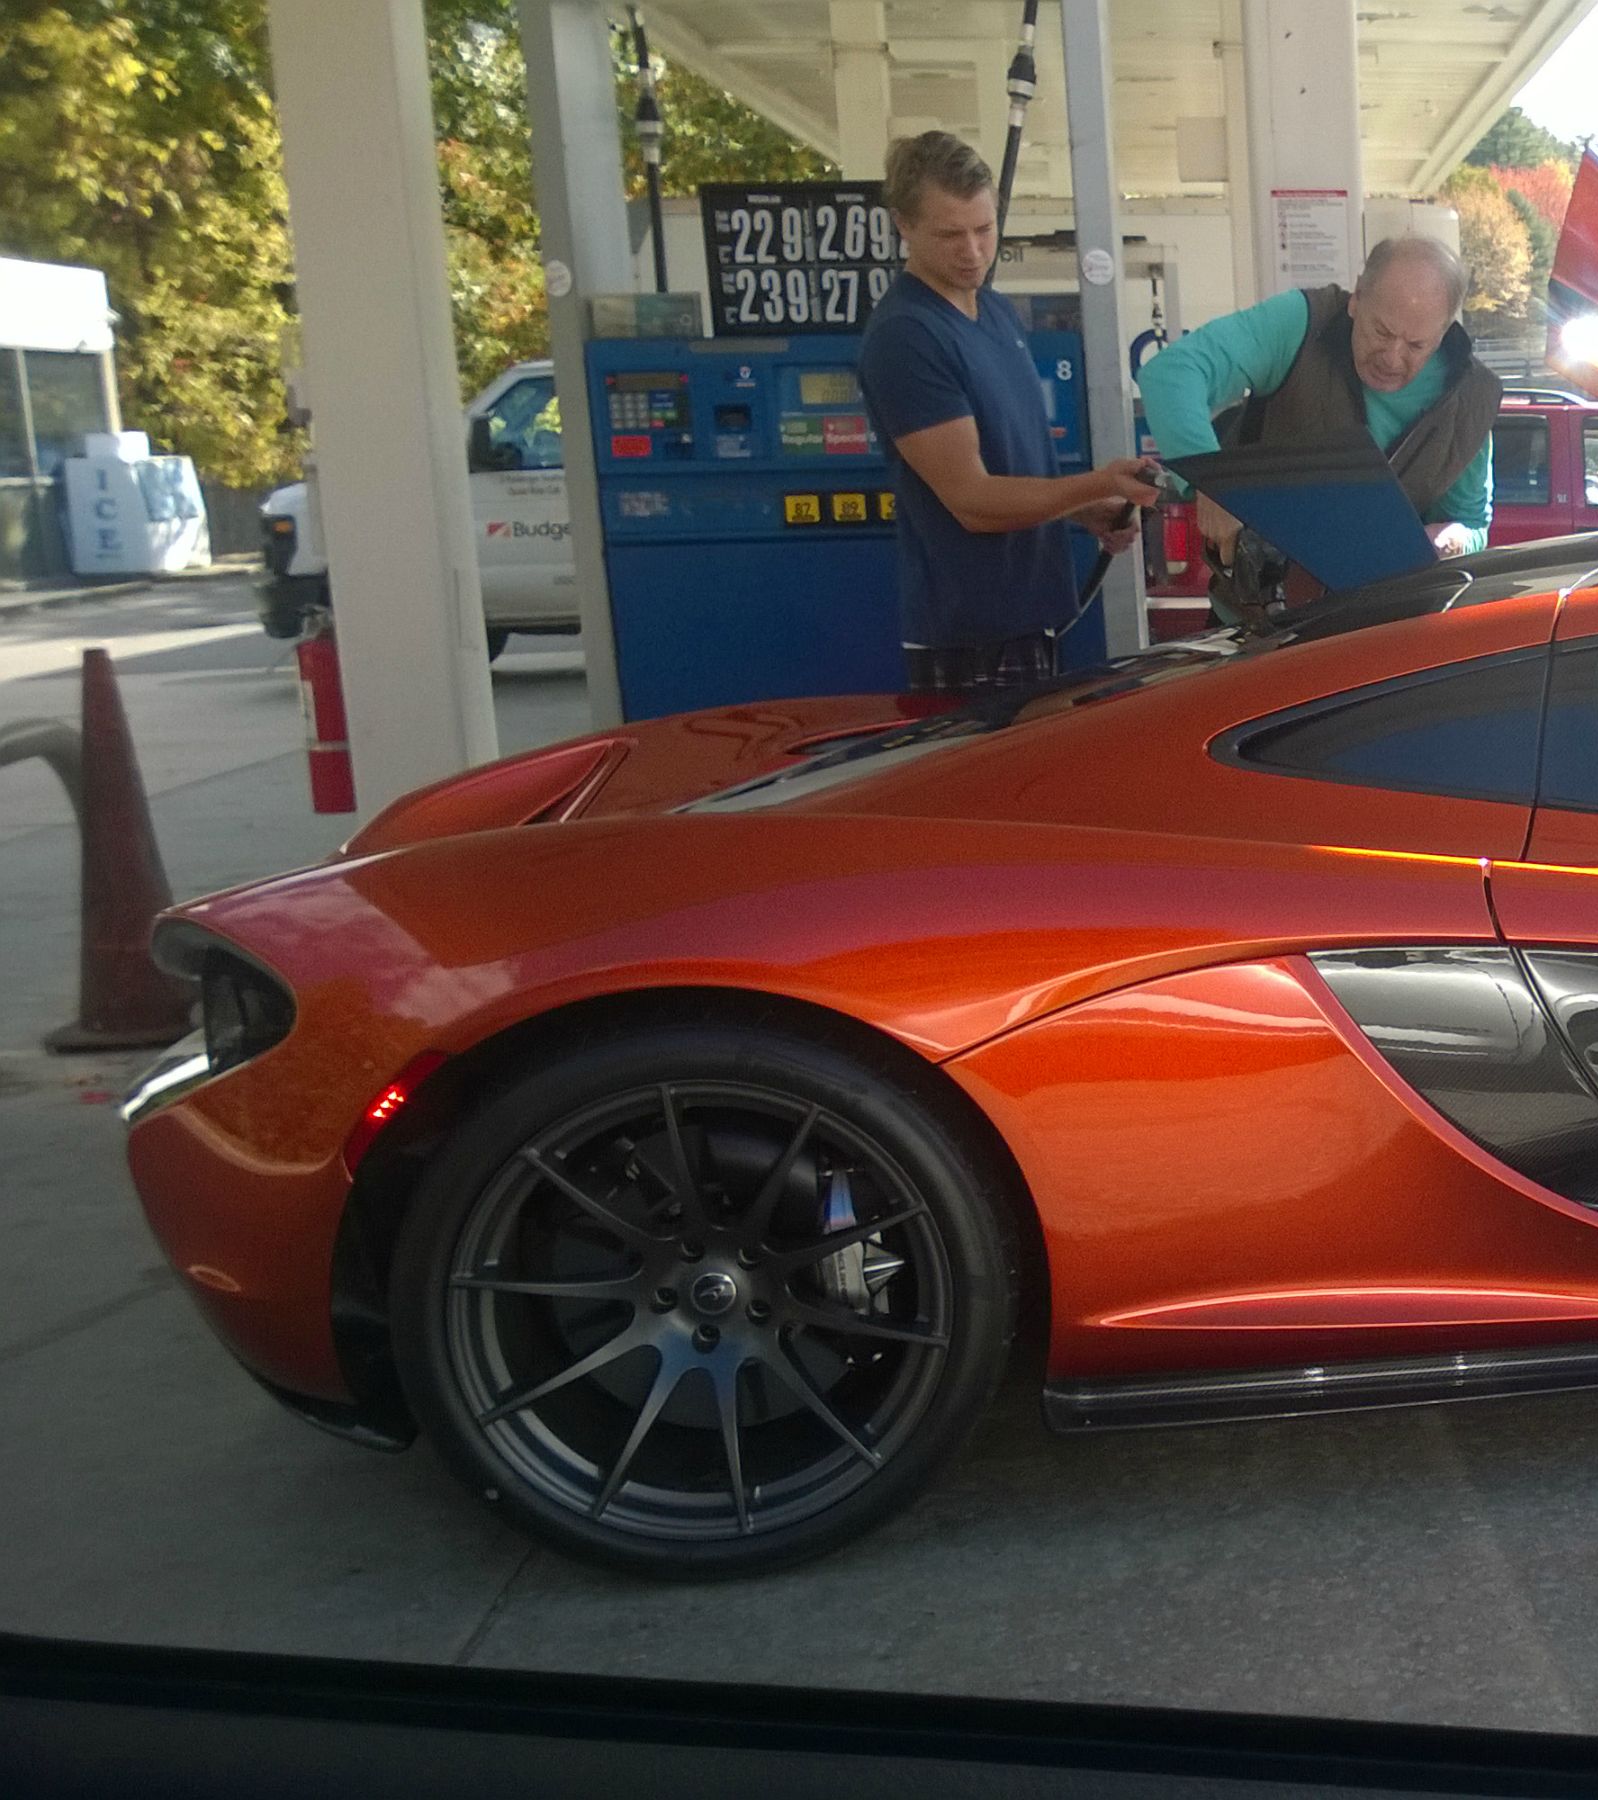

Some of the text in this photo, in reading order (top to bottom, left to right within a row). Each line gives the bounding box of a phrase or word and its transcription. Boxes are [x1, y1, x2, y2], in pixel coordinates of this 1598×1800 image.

[736, 269, 809, 323] 239
[1056, 359, 1073, 381] 8
[512, 520, 571, 541] Budge
